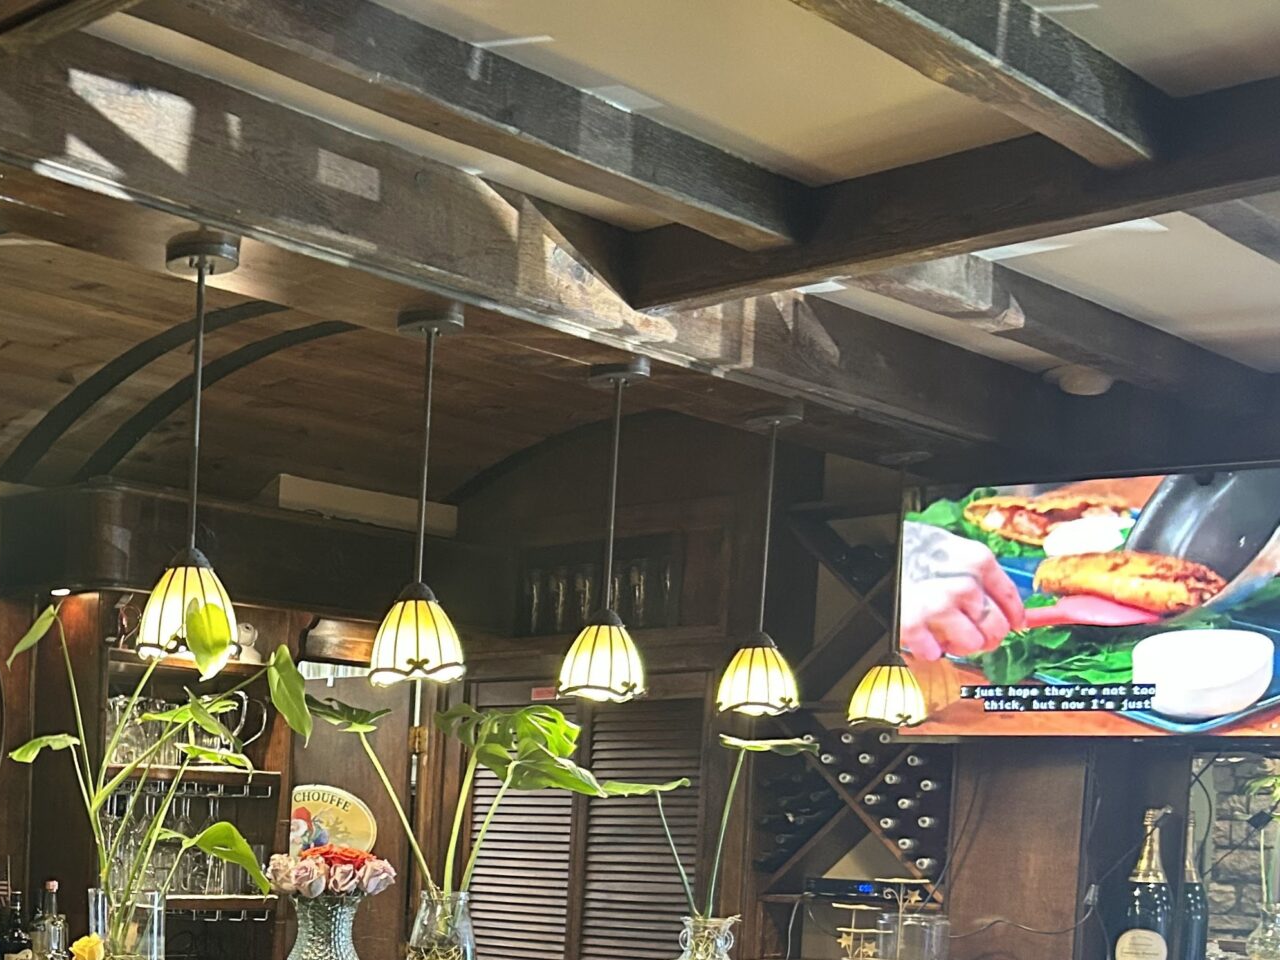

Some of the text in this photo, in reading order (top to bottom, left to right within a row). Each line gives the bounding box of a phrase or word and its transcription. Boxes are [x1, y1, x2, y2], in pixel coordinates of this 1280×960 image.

[960, 685, 1156, 699] I just hope they're not too
[984, 699, 1151, 711] thick, but now I'm just
[293, 791, 352, 812] CHOUFFE
